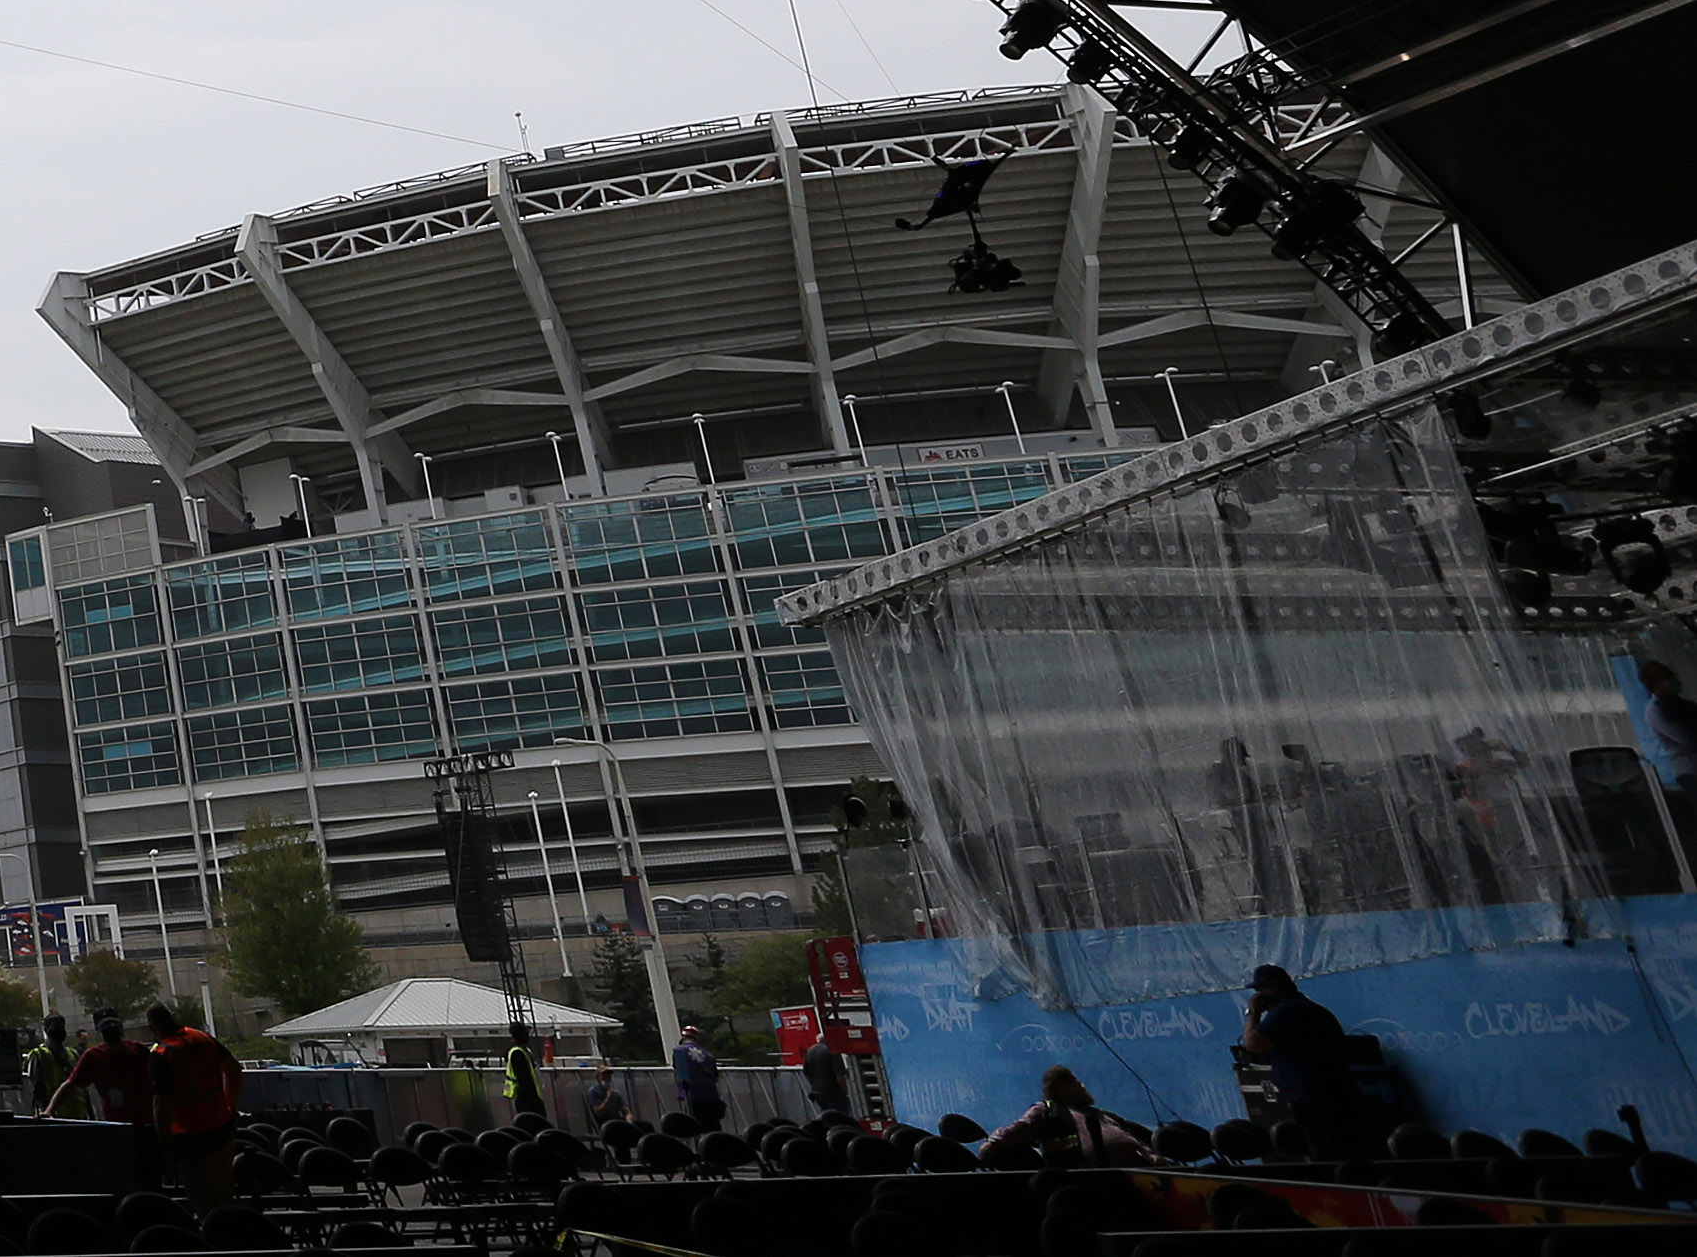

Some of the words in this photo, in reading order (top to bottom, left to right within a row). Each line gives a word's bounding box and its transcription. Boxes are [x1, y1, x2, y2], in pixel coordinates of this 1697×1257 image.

[946, 448, 979, 460] EATS
[1097, 1004, 1215, 1042] CLEVELAND
[1465, 994, 1632, 1040] CLEVELAND
